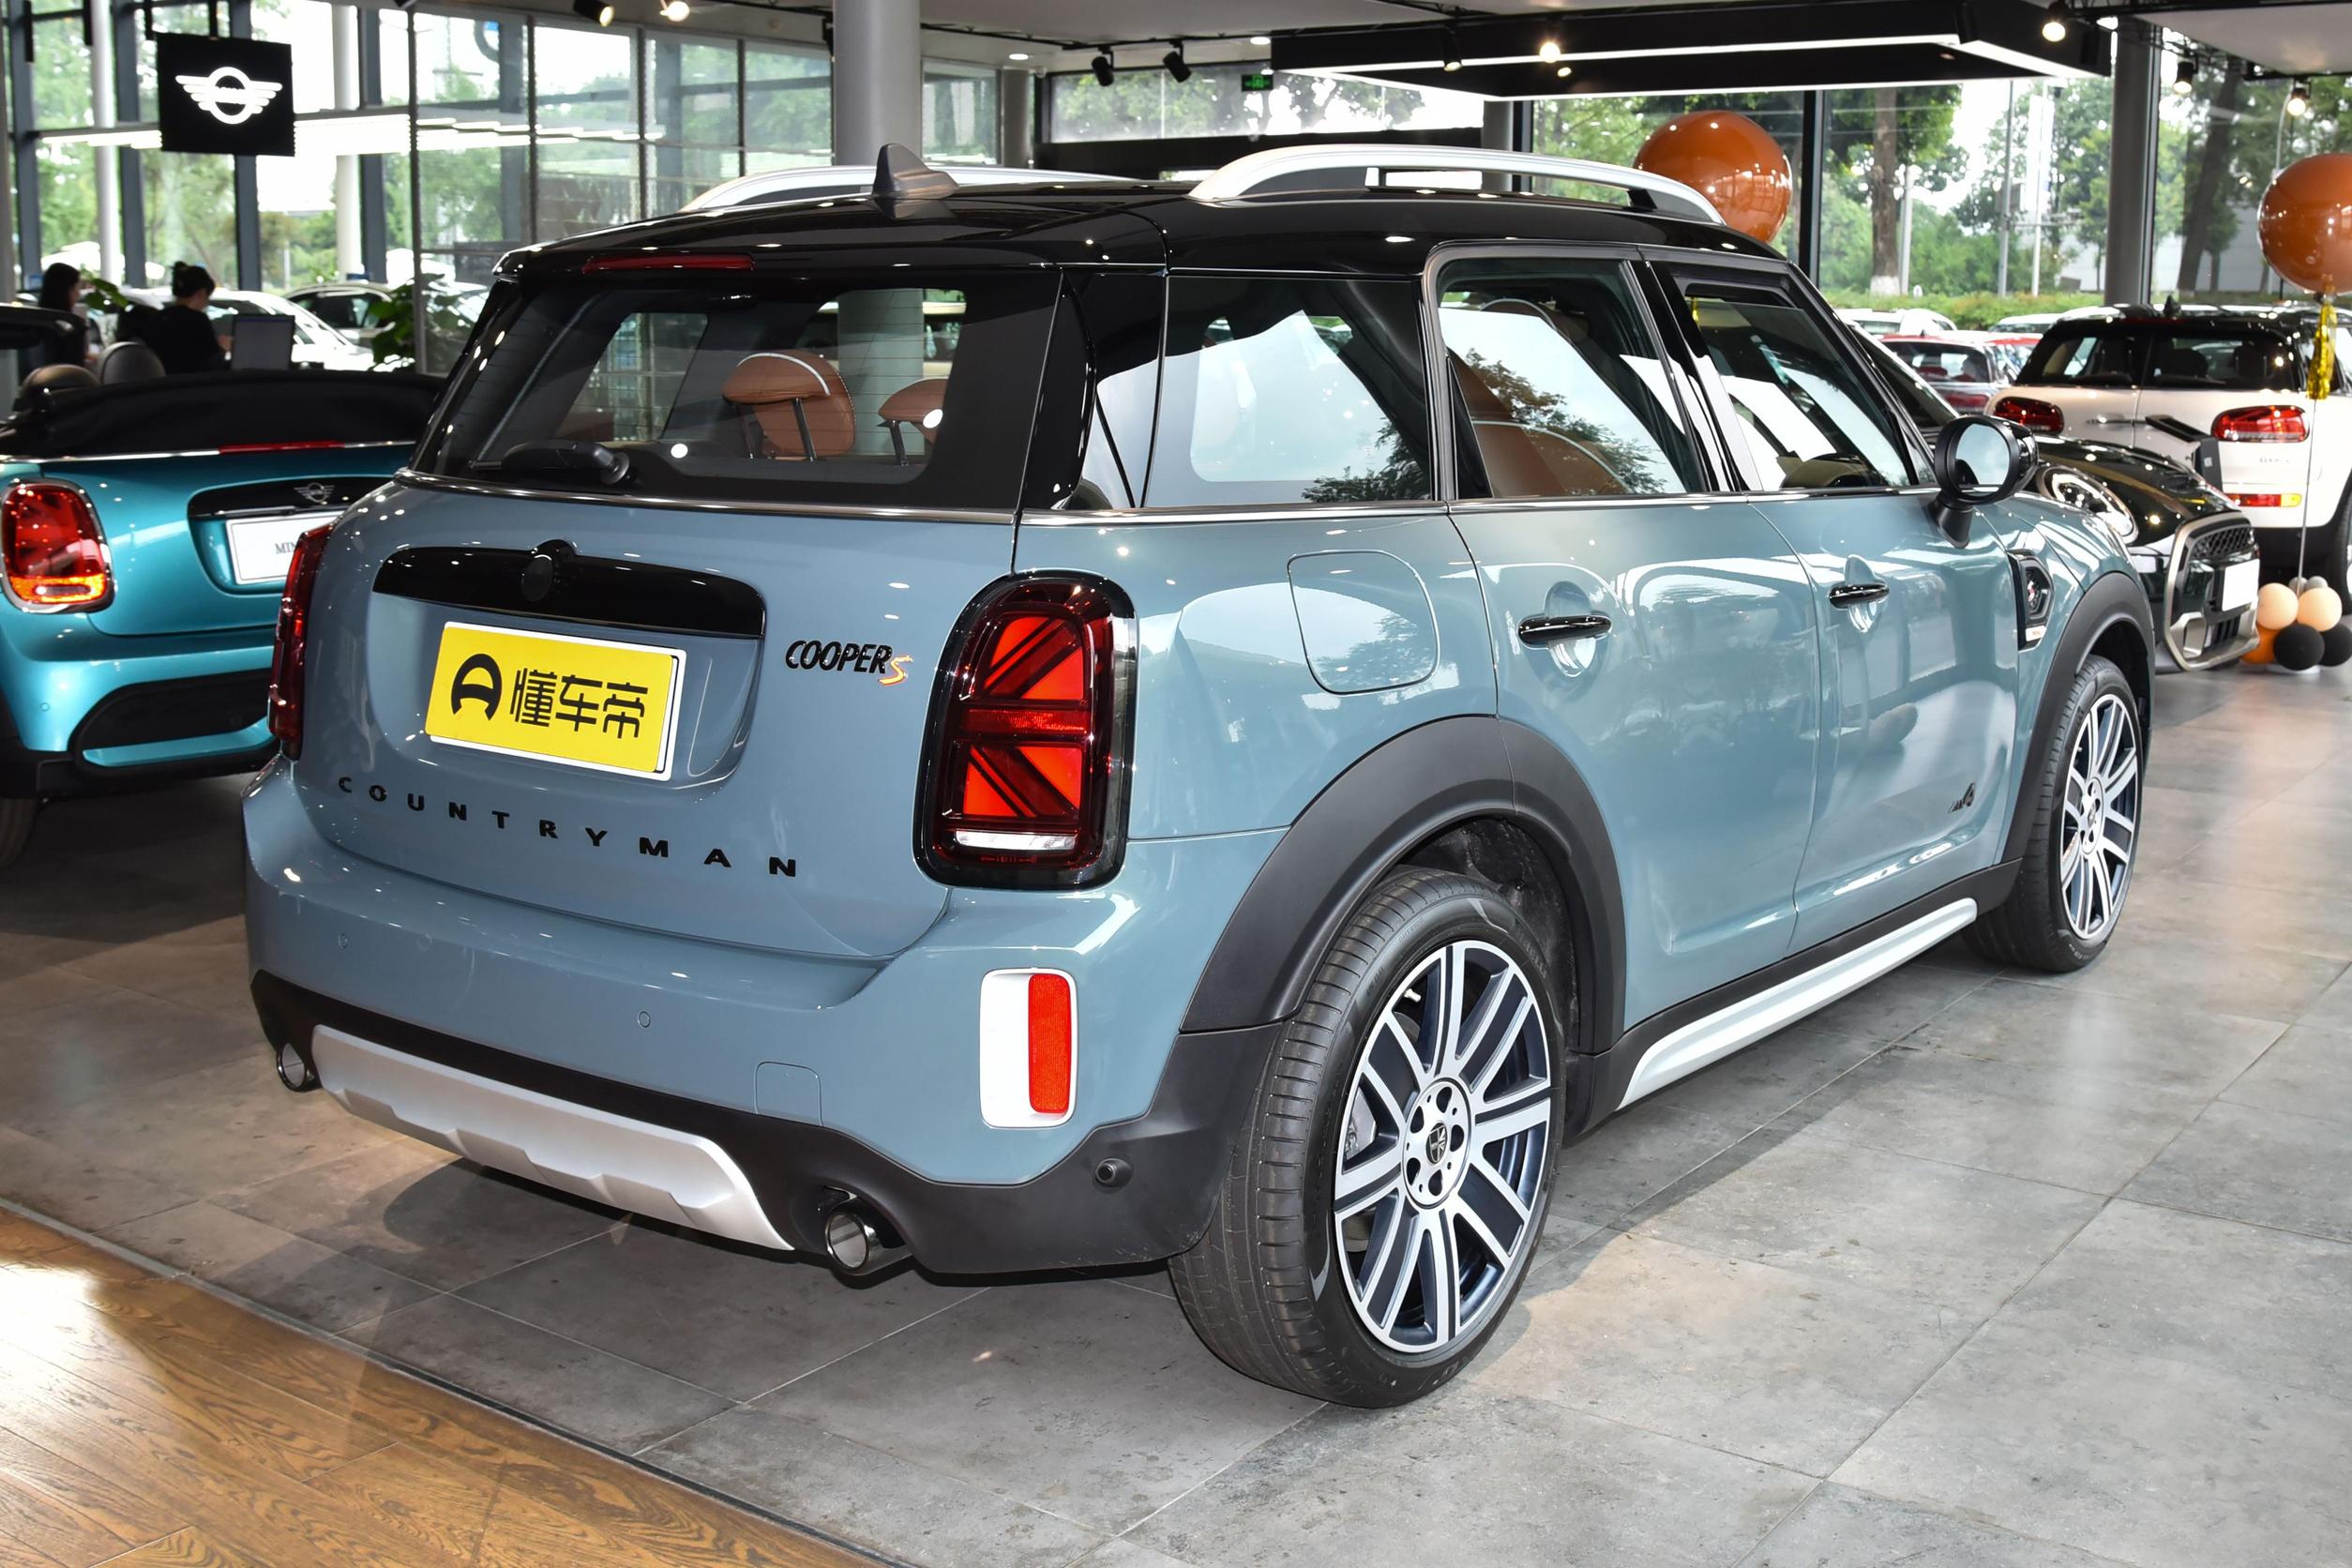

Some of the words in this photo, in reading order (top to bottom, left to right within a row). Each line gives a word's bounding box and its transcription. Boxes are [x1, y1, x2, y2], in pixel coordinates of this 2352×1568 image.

[785, 640, 894, 674] COOPER
[877, 655, 913, 686] S
[509, 667, 649, 740] 懂车帝
[338, 776, 797, 878] COUNTRYMAN
